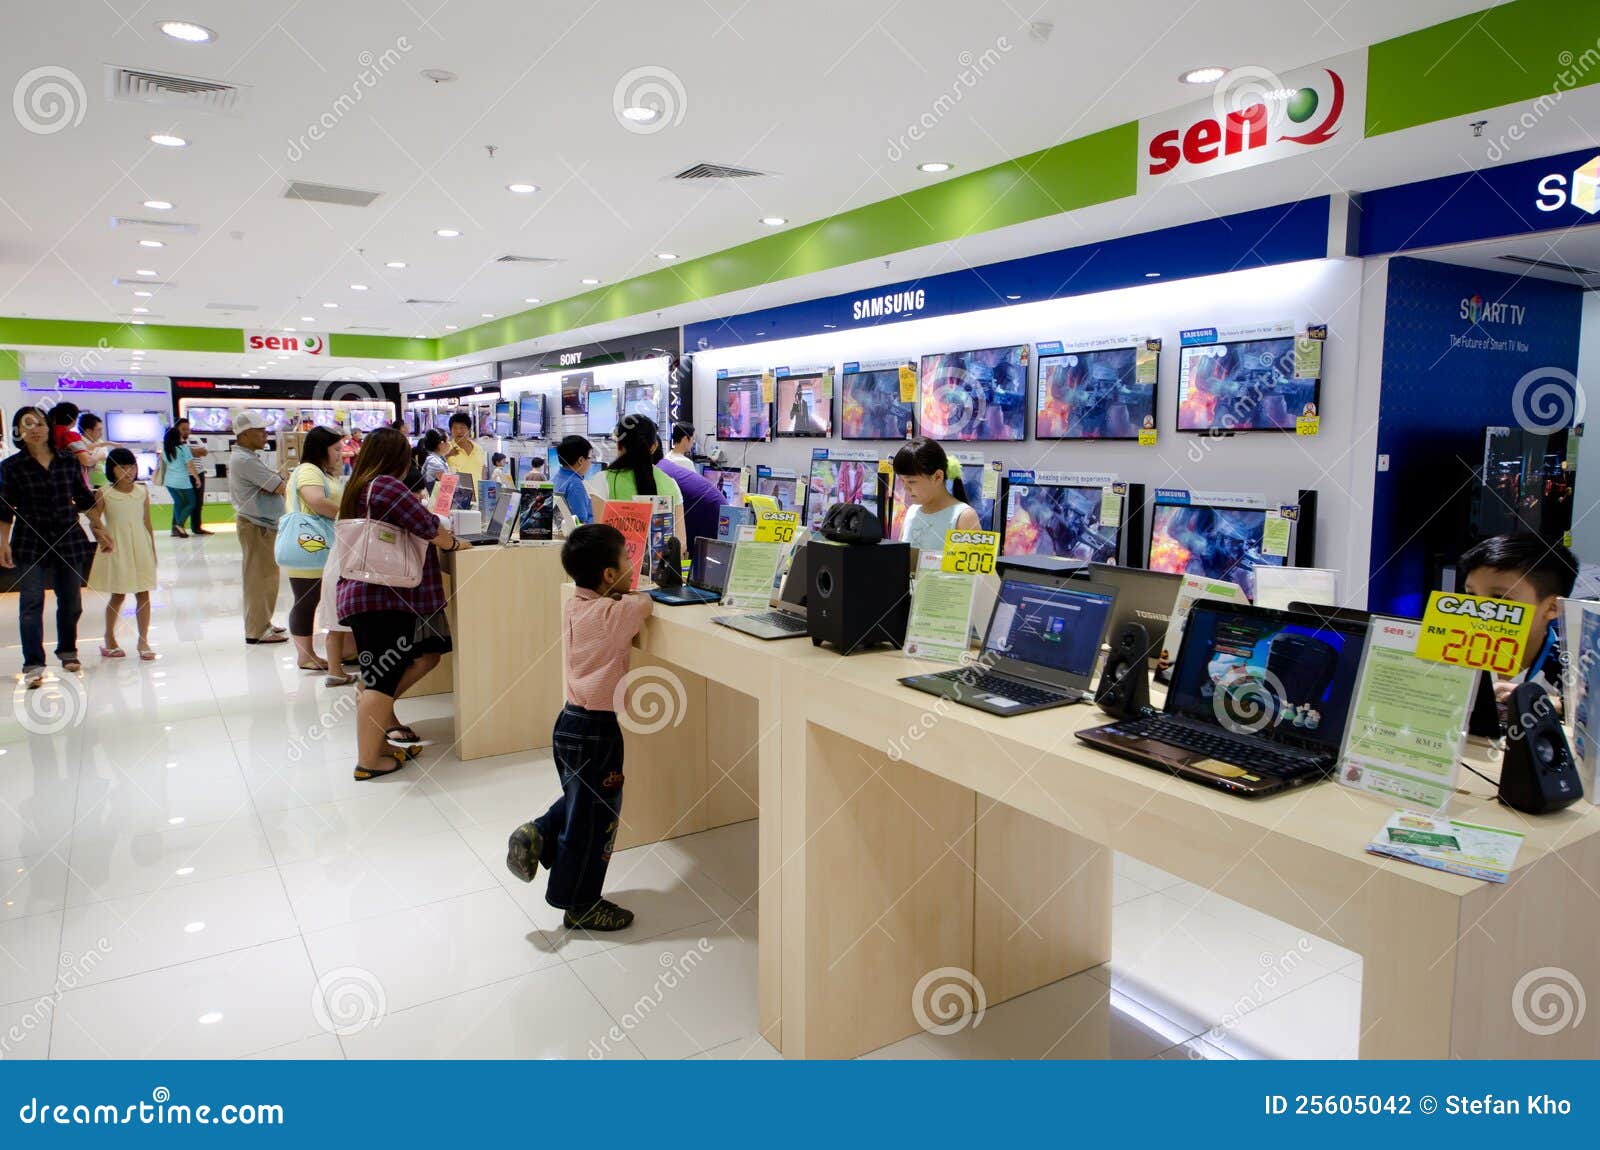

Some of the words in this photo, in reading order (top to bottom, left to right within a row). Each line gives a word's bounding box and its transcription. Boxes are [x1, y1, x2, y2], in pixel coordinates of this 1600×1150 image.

[853, 289, 925, 320] SAMSUNG
[1510, 304, 1526, 326] TV
[1183, 330, 1213, 339] SAMSUNG
[1461, 335, 1482, 349] Future
[560, 352, 582, 366] SONY
[774, 526, 794, 543] 50
[955, 551, 994, 574] 200
[1470, 621, 1520, 637] Voucher
[1427, 625, 1446, 636] RM
[1442, 628, 1519, 673] 200
